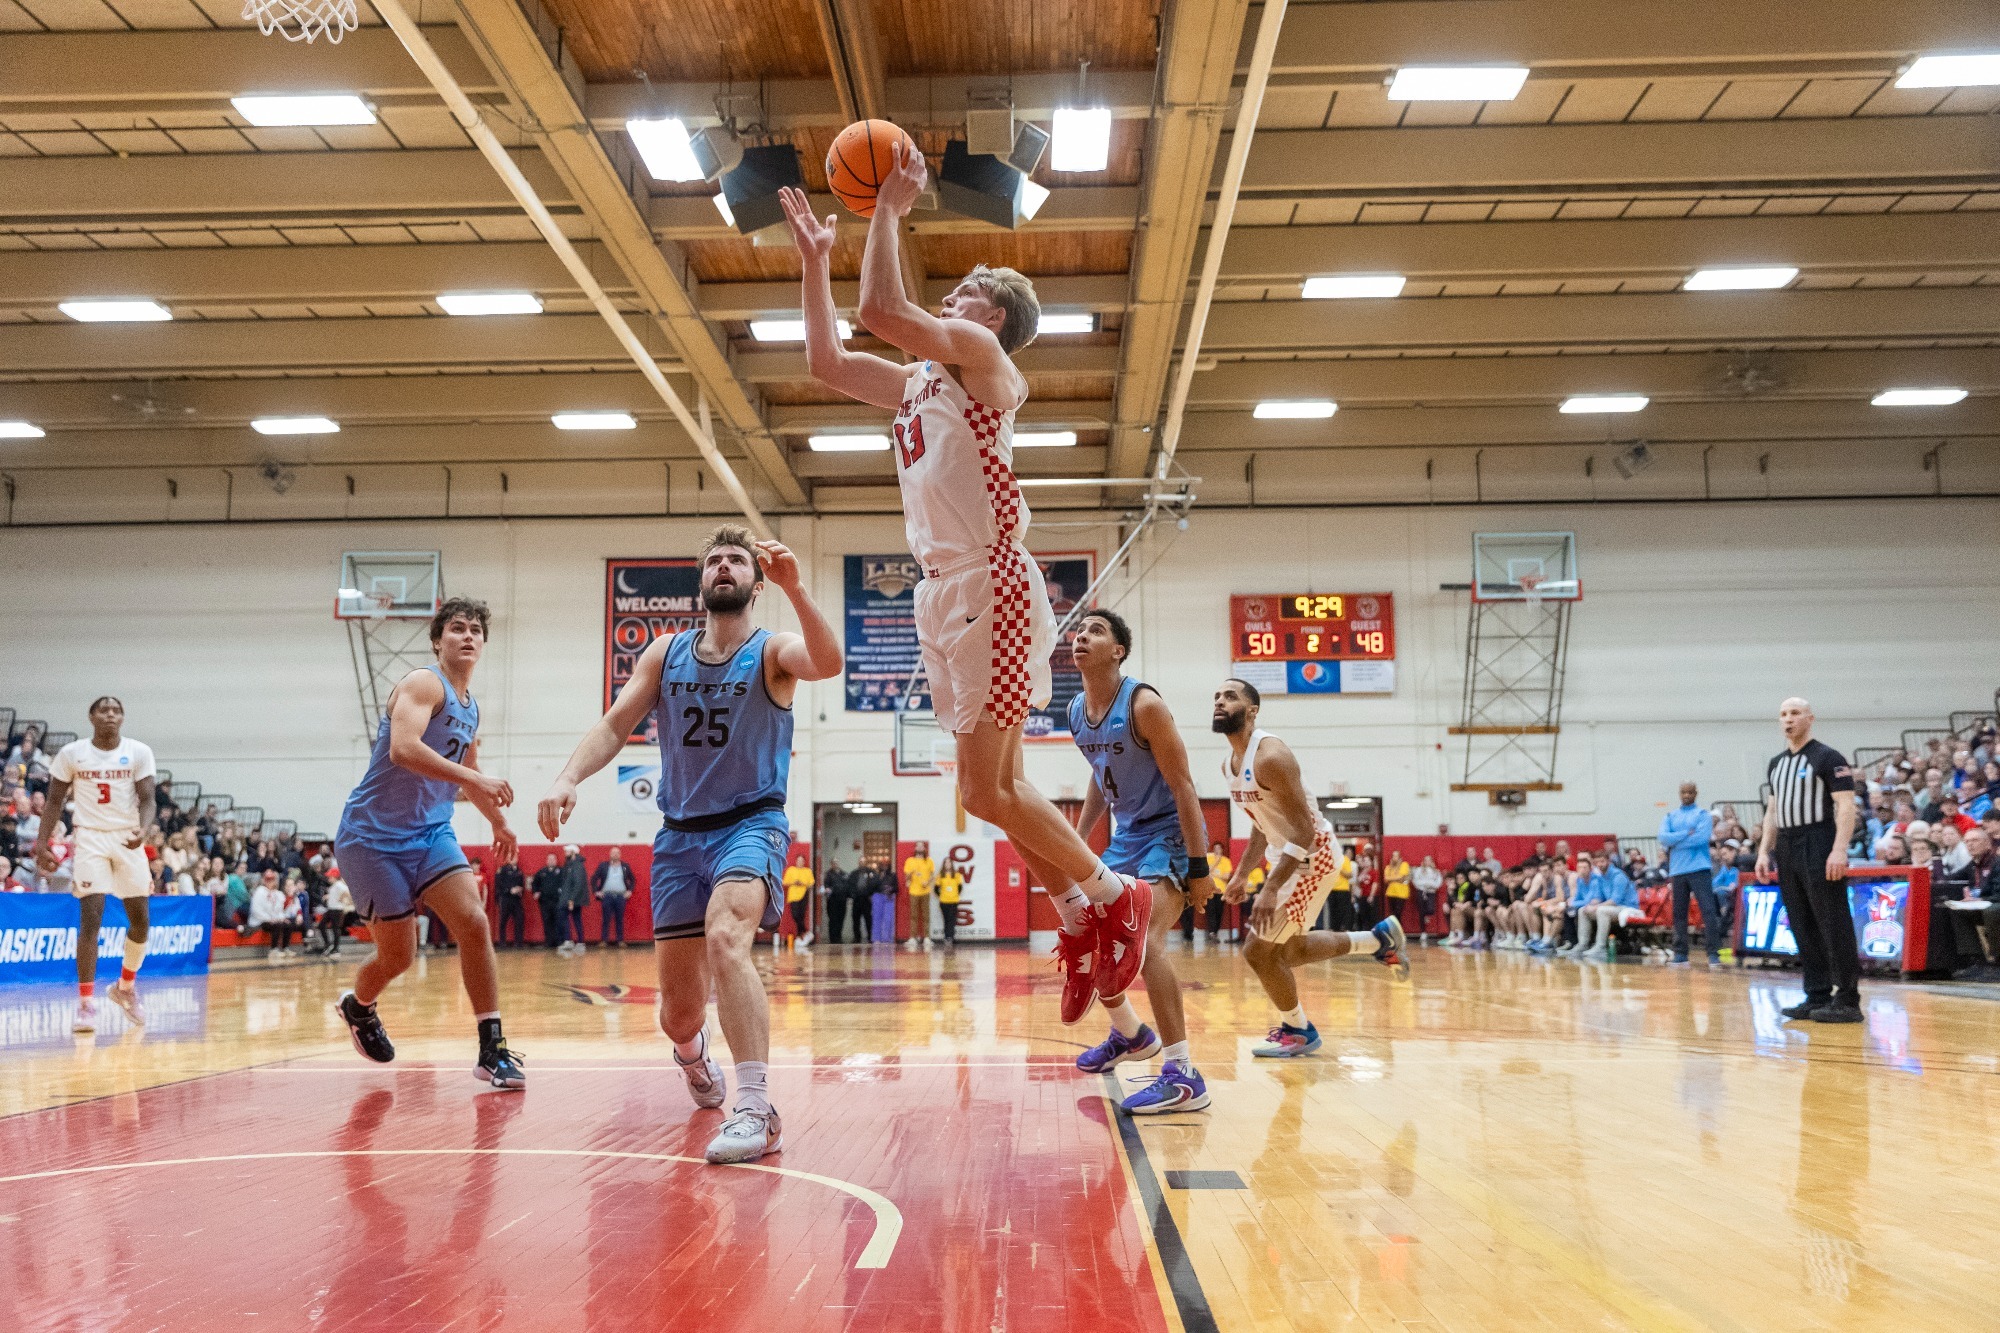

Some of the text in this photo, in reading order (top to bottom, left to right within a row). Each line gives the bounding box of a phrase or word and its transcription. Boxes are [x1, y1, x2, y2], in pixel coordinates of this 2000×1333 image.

[894, 413, 926, 470] 13
[866, 562, 915, 578] LEC
[615, 596, 707, 612] WELCOME T
[1295, 596, 1342, 619] 9:29
[1244, 621, 1272, 633] OWLS
[1350, 620, 1382, 632] GUEST
[1248, 632, 1276, 656] 50
[1306, 633, 1320, 653] 2
[1356, 631, 1385, 654] 48
[668, 681, 749, 697] TUFTS
[682, 706, 730, 748] 25
[1077, 741, 1125, 756] TUFTS
[105, 769, 132, 780] STATE
[1102, 765, 1119, 799] 4
[97, 783, 111, 804] 3
[949, 844, 975, 926] OWS
[0, 927, 78, 964] ASKETBA
